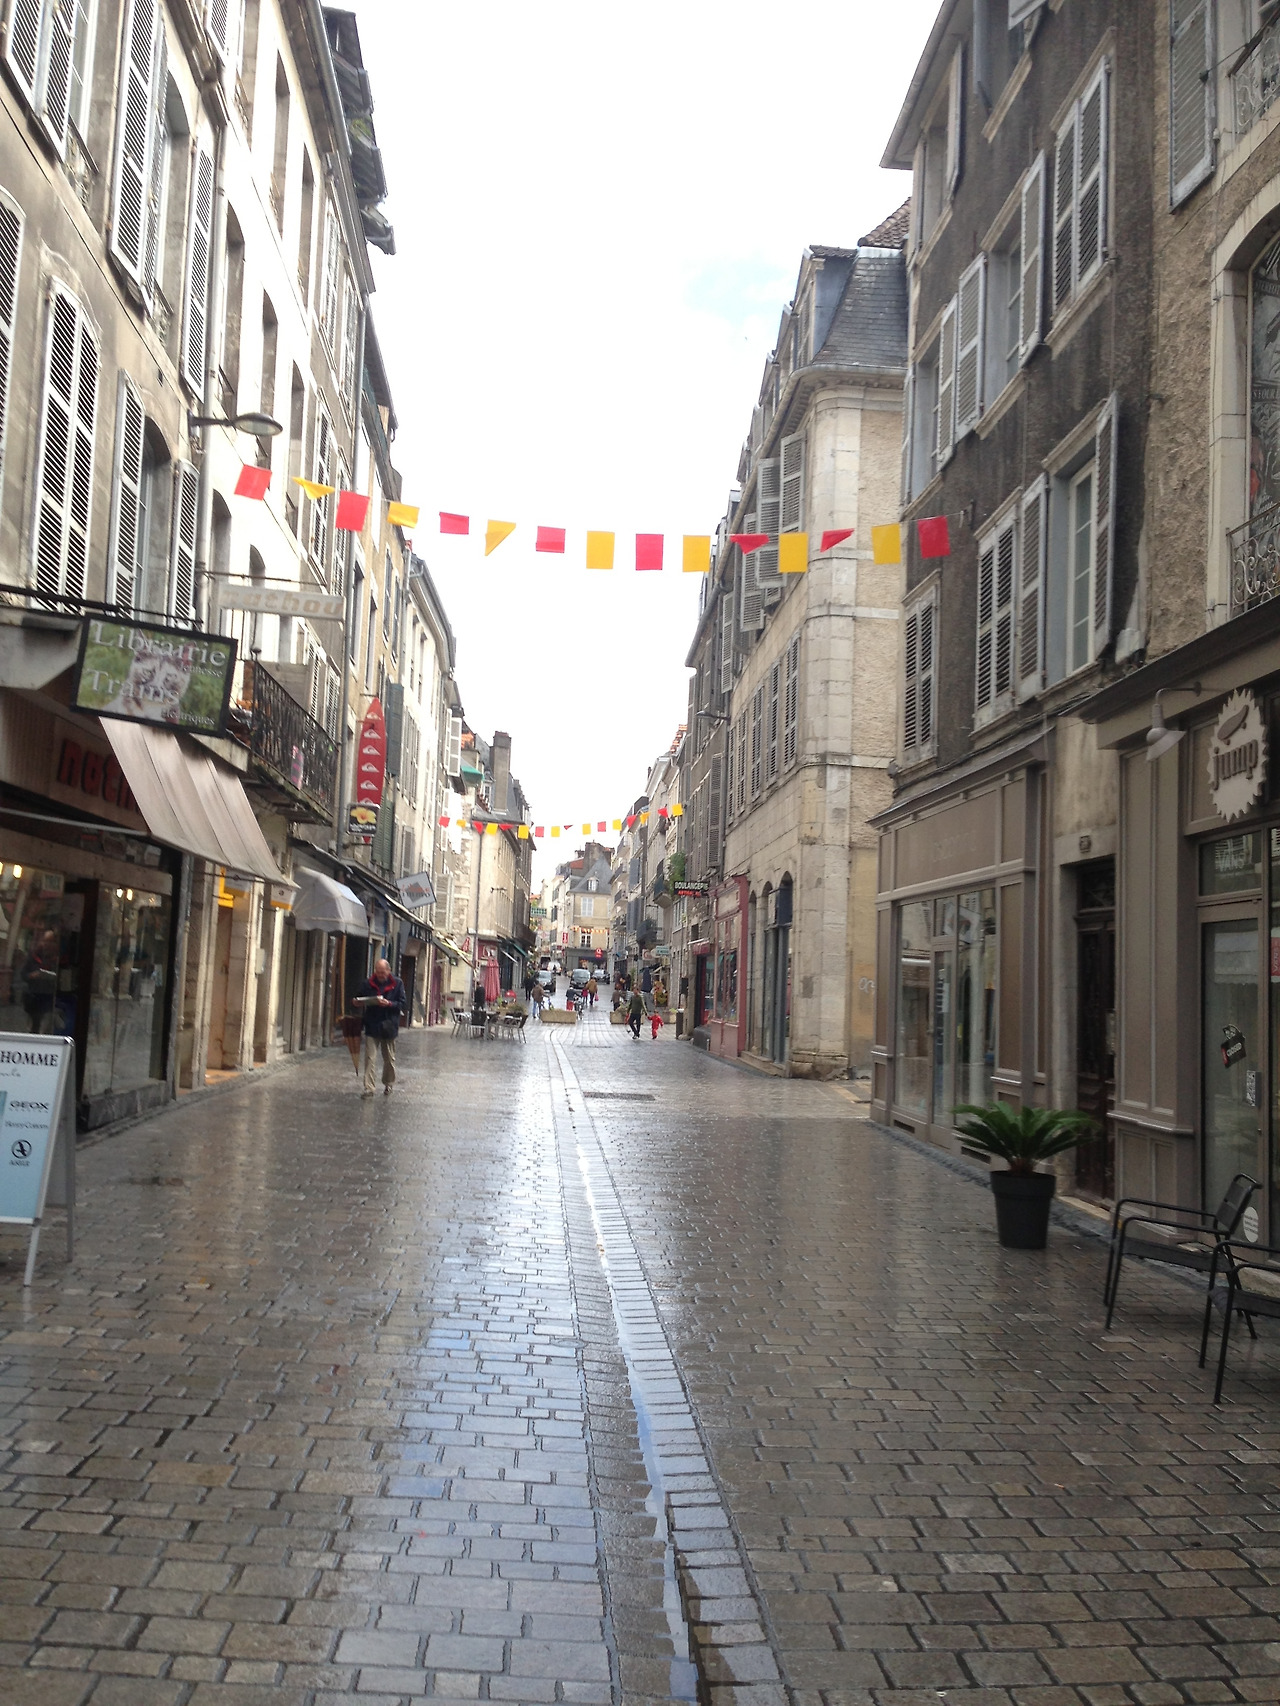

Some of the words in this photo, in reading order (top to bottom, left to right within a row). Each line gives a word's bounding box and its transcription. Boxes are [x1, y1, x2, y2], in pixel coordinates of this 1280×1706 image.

[90, 619, 227, 668] Librairie
[86, 668, 181, 705] Trains
[1211, 738, 1259, 791] jump
[0, 1050, 59, 1067] HOMME
[9, 1100, 50, 1110] GEOX
